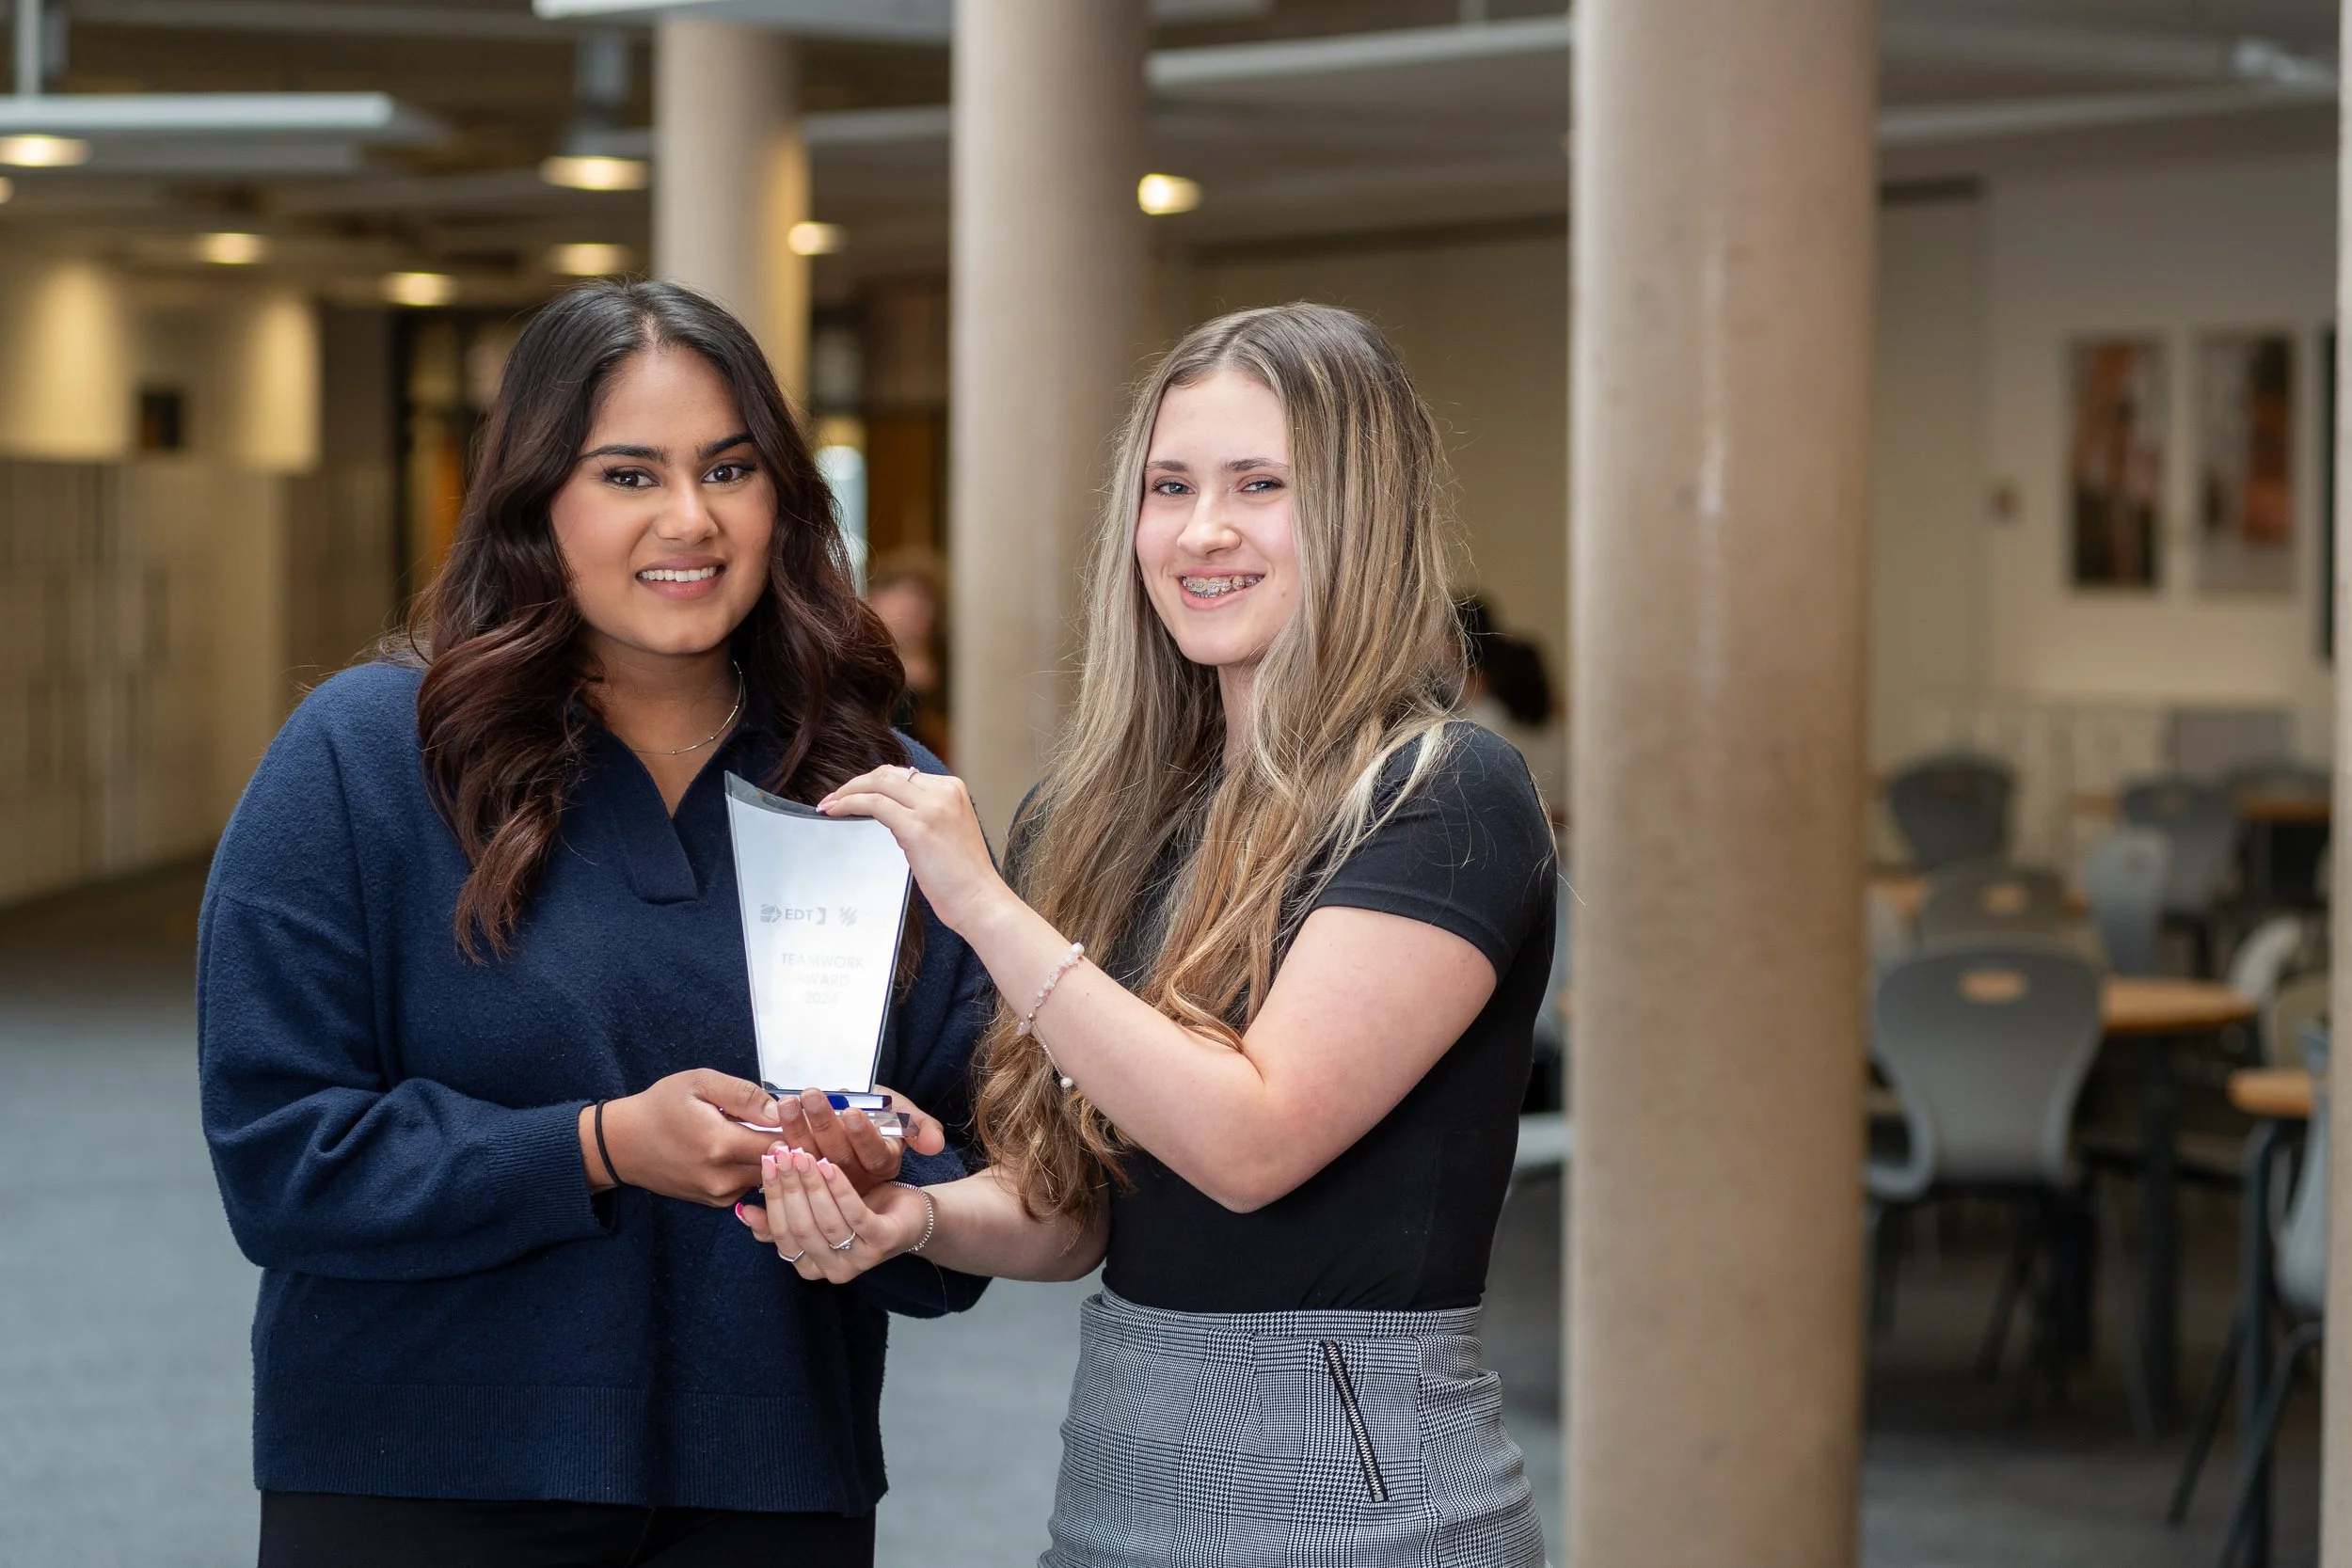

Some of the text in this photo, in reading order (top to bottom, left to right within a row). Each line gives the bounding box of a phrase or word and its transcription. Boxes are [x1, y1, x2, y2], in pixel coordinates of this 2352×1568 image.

[785, 909, 814, 922] EDT
[782, 953, 865, 971] TEAMWORK
[795, 972, 850, 987] AWARD
[805, 991, 837, 1005] 2024
